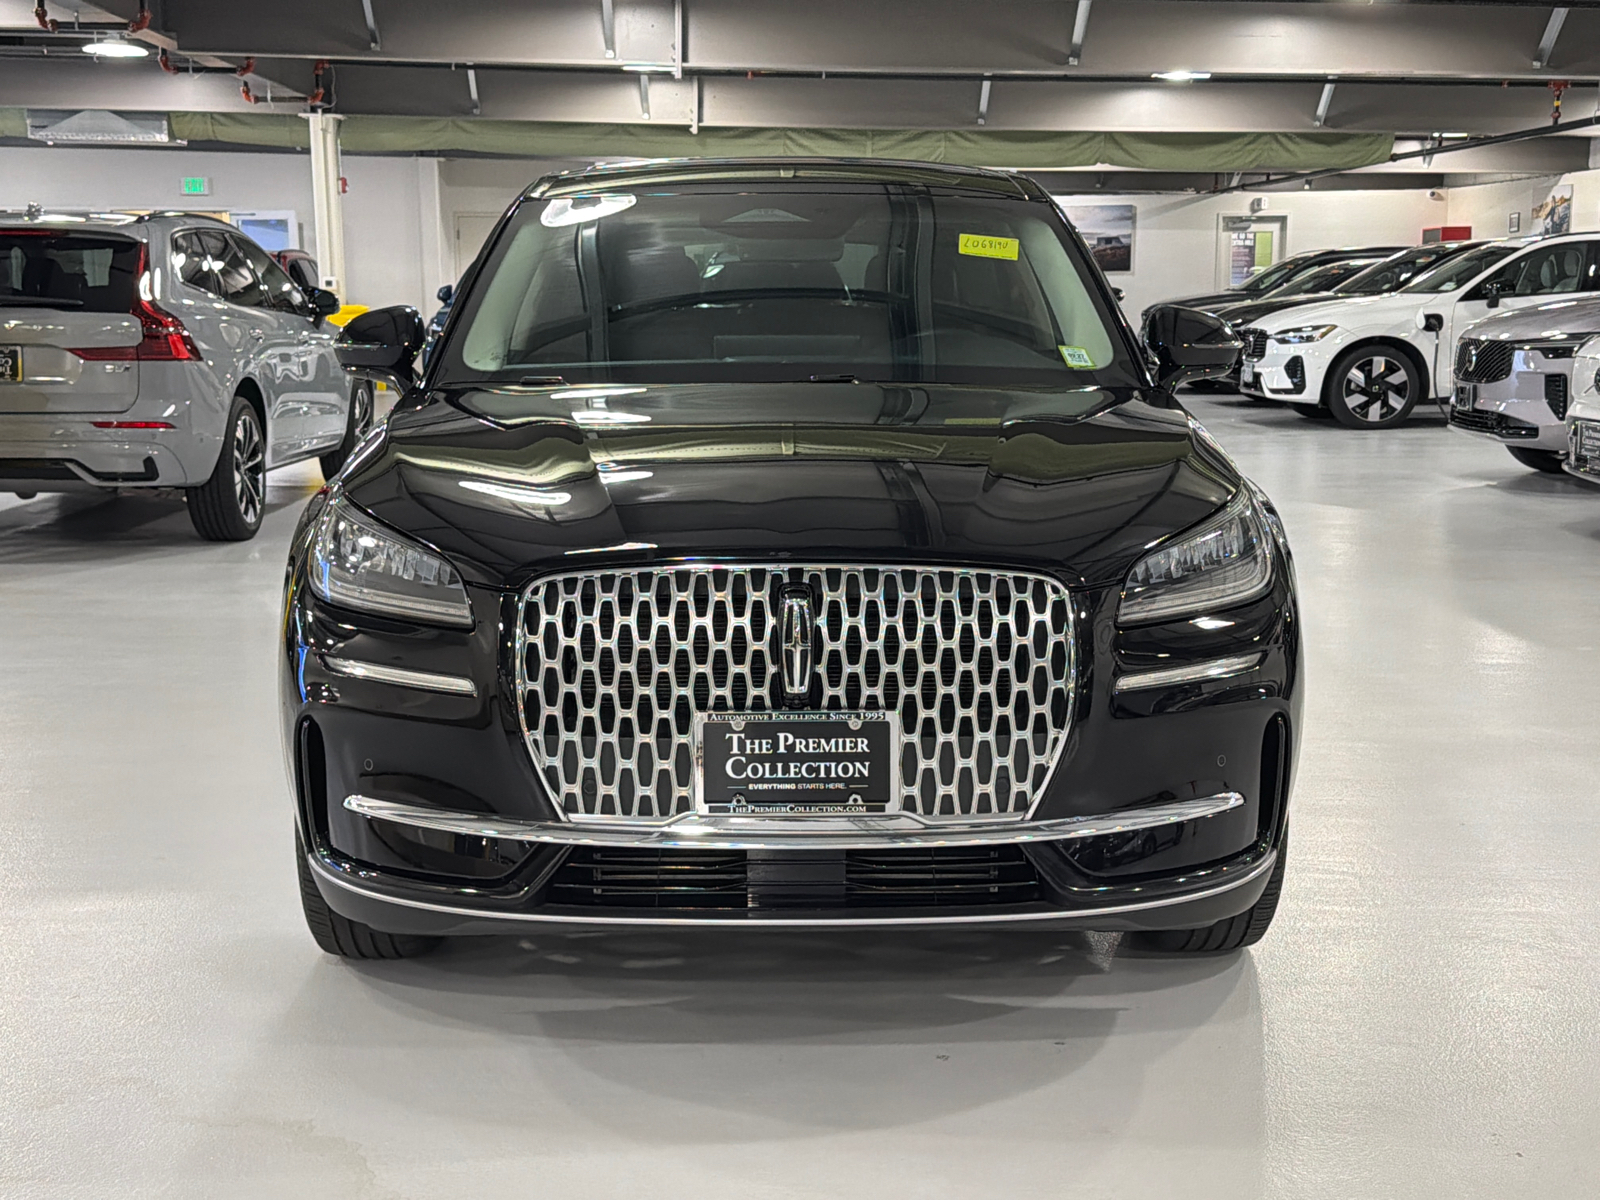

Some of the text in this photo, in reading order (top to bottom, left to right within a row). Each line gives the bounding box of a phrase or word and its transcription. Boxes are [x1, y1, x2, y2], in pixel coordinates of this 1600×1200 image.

[710, 712, 885, 721] AUTOMOTIVE EXCELLENCE SINCE 1995
[725, 732, 870, 754] THE PREMIER
[725, 756, 870, 779] COLLECTION
